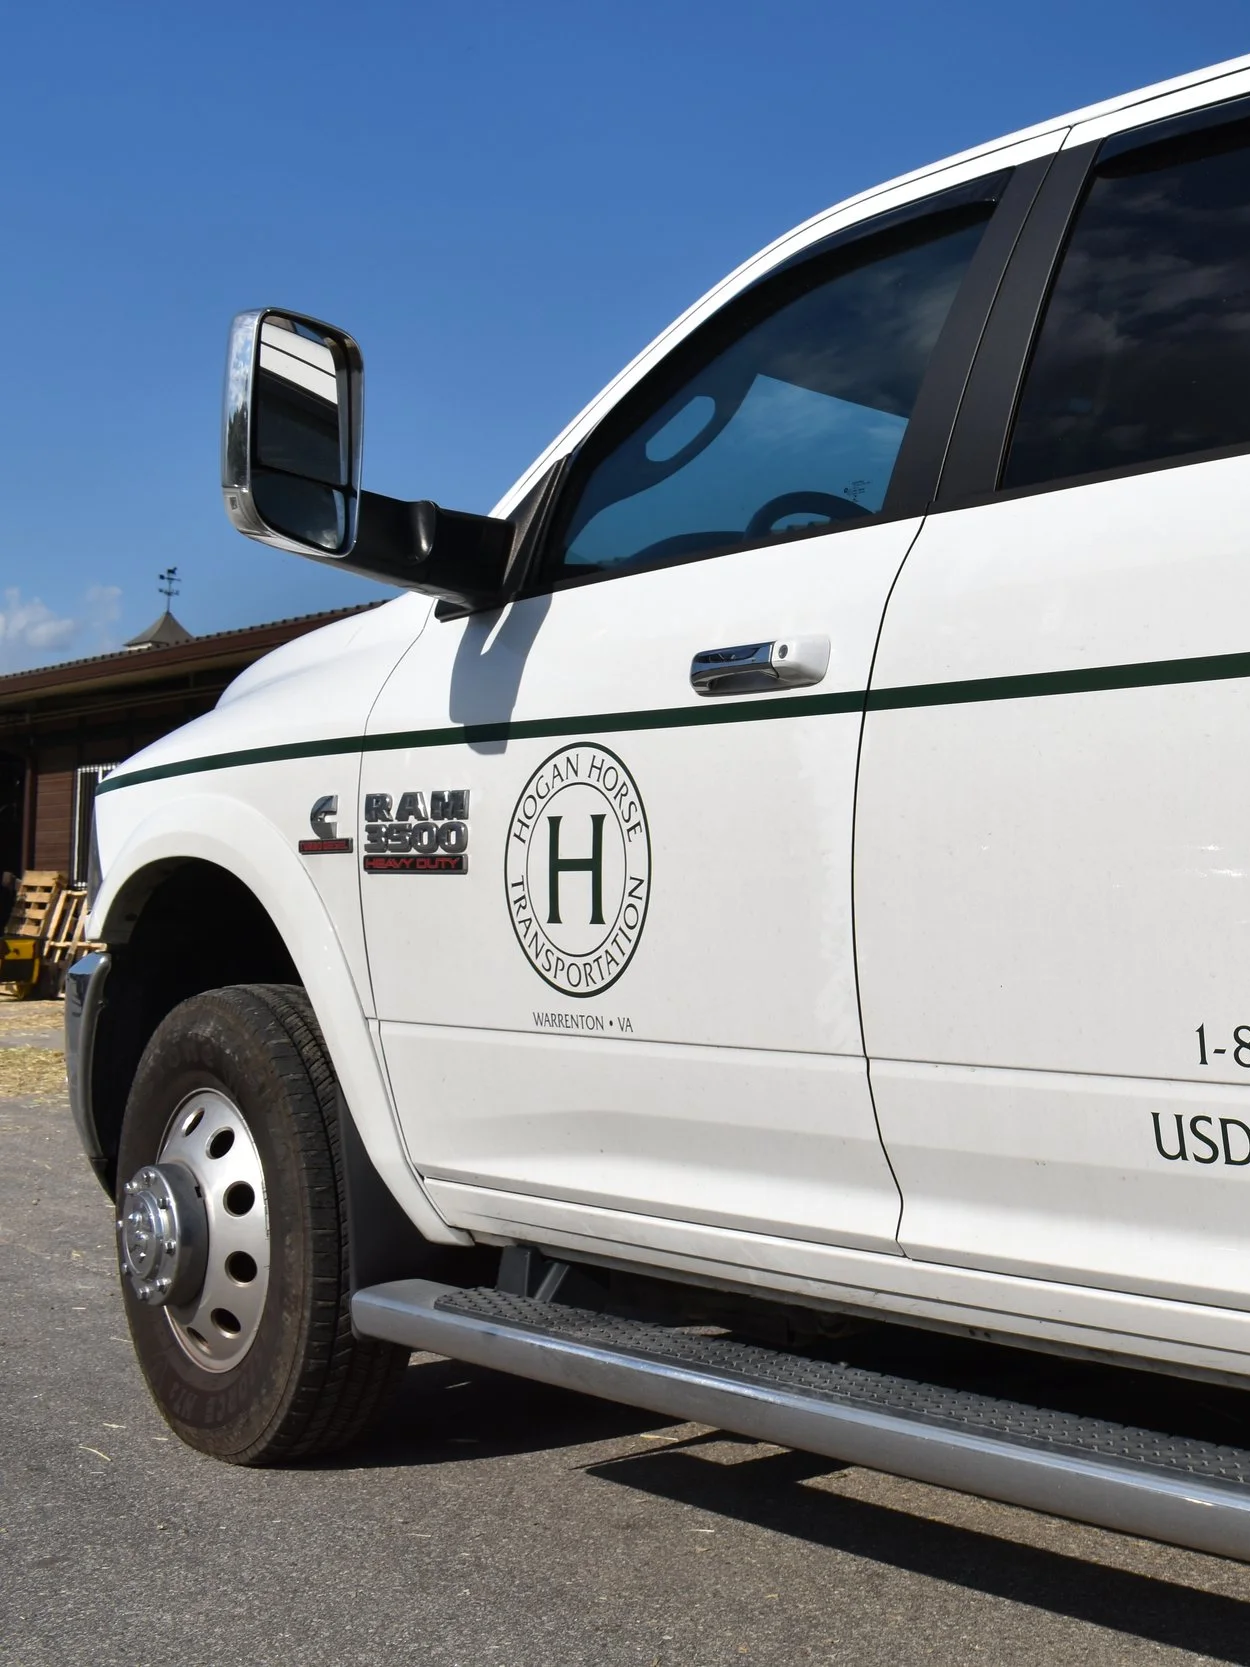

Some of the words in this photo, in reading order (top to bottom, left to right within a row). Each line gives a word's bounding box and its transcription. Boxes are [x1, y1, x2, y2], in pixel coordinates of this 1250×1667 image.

[364, 789, 470, 822] RAM
[513, 753, 580, 845] HOGAN
[587, 754, 643, 843] HORSE
[363, 821, 468, 853] 3500
[365, 857, 414, 869] HEAVY
[416, 856, 460, 869] DUTY
[546, 813, 607, 925] H
[511, 874, 645, 988] TRANSPORTATION
[532, 1012, 604, 1030] WARRENTON
[617, 1016, 634, 1033] VA
